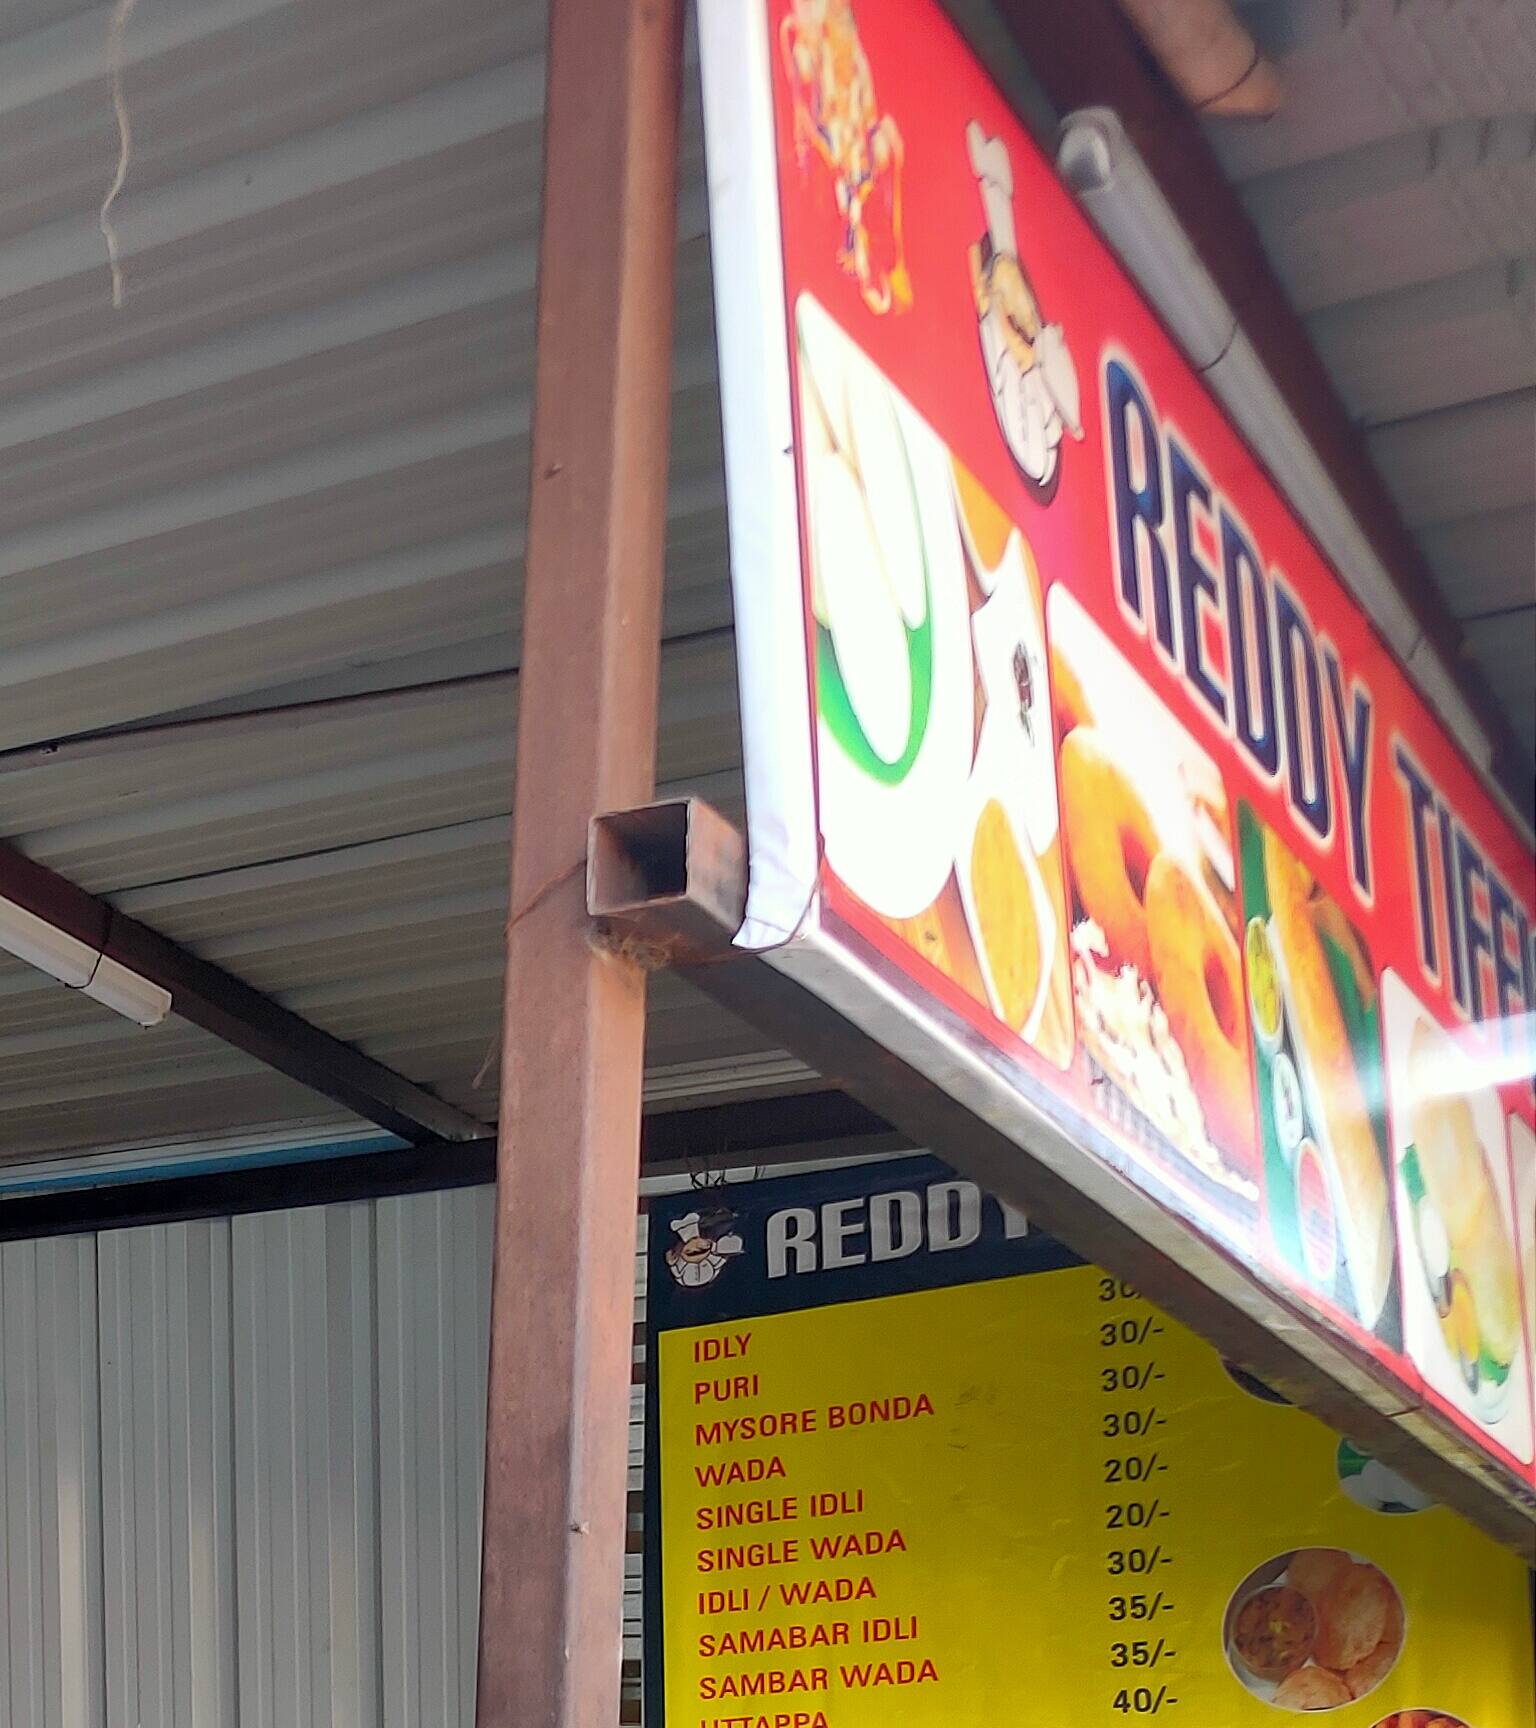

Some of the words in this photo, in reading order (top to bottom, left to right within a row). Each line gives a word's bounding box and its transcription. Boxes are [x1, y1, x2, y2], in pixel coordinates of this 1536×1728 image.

[1104, 358, 1372, 893] REDDY
[694, 1335, 752, 1362] IDLY
[694, 1376, 759, 1404] PURI
[1100, 1317, 1164, 1346] 30/-
[695, 1409, 816, 1446] MYSORE
[829, 1395, 934, 1428] BONDA
[1101, 1362, 1166, 1392] 30/-
[695, 1456, 786, 1488] WADA
[1103, 1408, 1167, 1437] 30/-
[697, 1497, 797, 1531] SINGLE
[810, 1490, 864, 1517] IDLI
[1105, 1453, 1169, 1483] 20/-
[698, 1540, 797, 1573] SINGLE
[810, 1530, 906, 1560] WADA
[1106, 1499, 1170, 1529] 20/-
[698, 1590, 752, 1615] IDLI
[780, 1576, 877, 1606] WADA
[1107, 1546, 1173, 1575] 30/-
[698, 1622, 850, 1658] SAMABAR
[862, 1616, 919, 1643] IDLI
[1109, 1592, 1175, 1621] 35/-
[699, 1667, 830, 1701] SAMBAR
[840, 1659, 939, 1689] WADA
[1111, 1639, 1177, 1668] 35/-
[1113, 1686, 1179, 1714] 40/-
